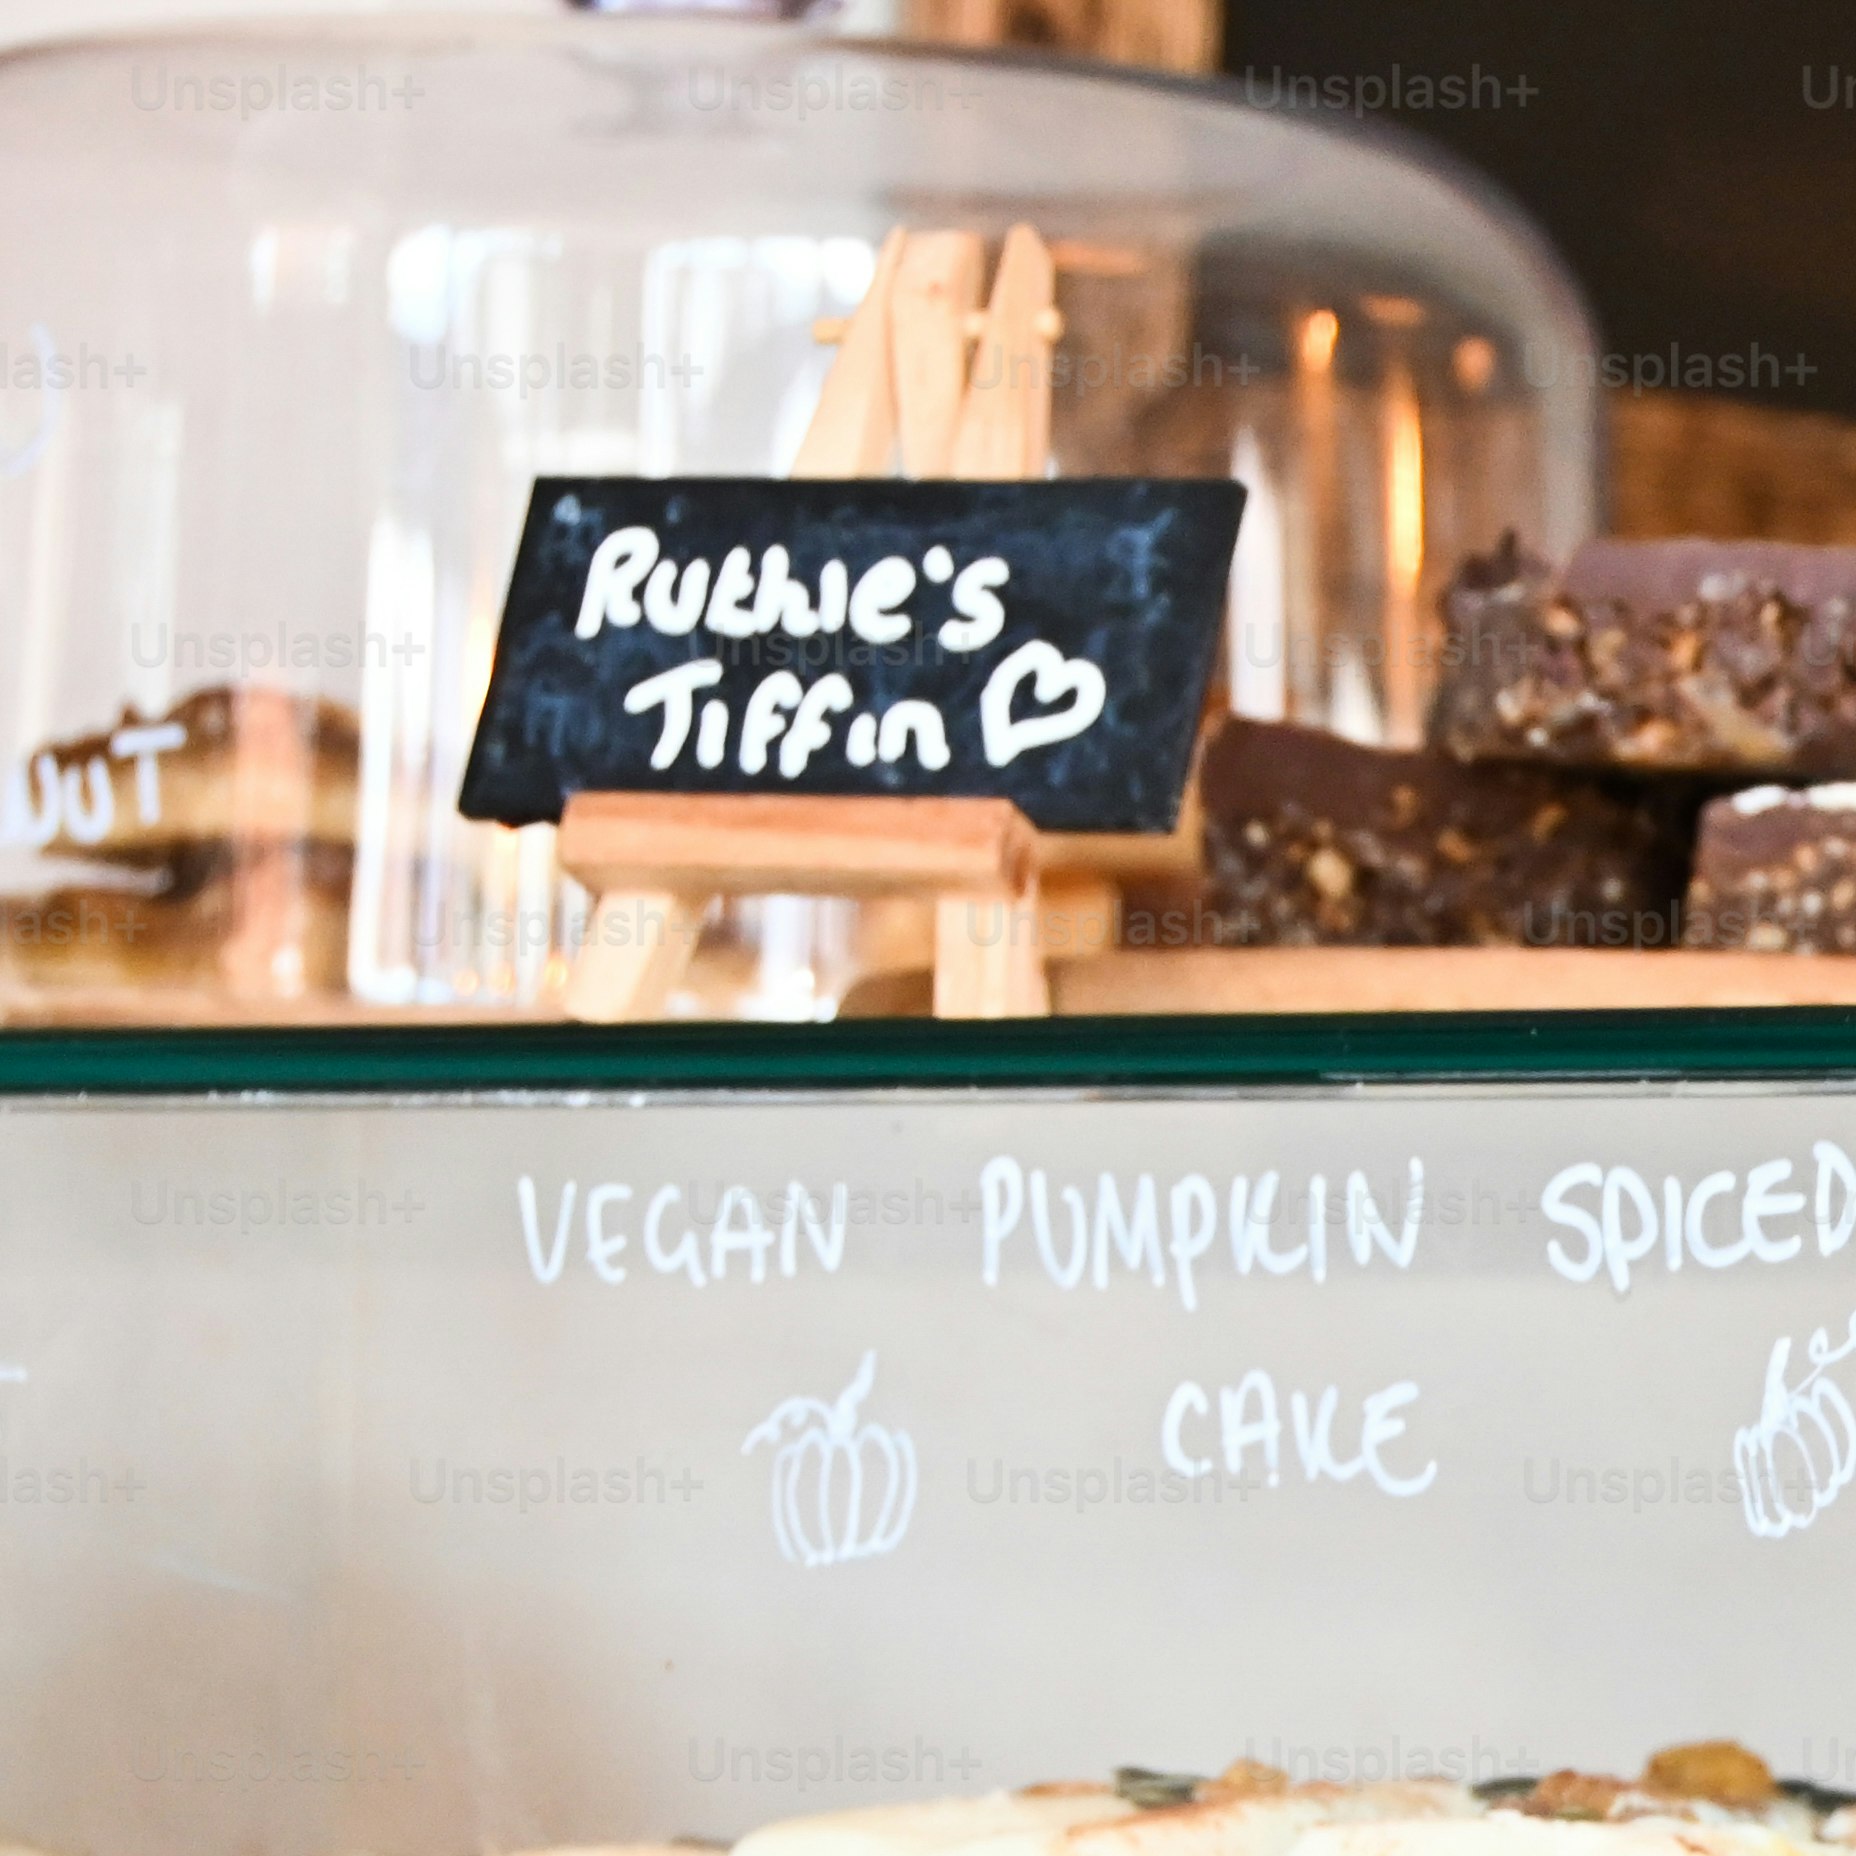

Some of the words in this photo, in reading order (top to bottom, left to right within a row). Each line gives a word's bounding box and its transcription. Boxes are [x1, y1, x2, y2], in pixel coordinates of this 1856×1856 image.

[625, 668, 948, 778] Tiffin
[519, 1175, 848, 1287] VEGAN
[980, 1155, 1425, 1309] PUMPKIN
[1162, 1368, 1436, 1497] CAKE
